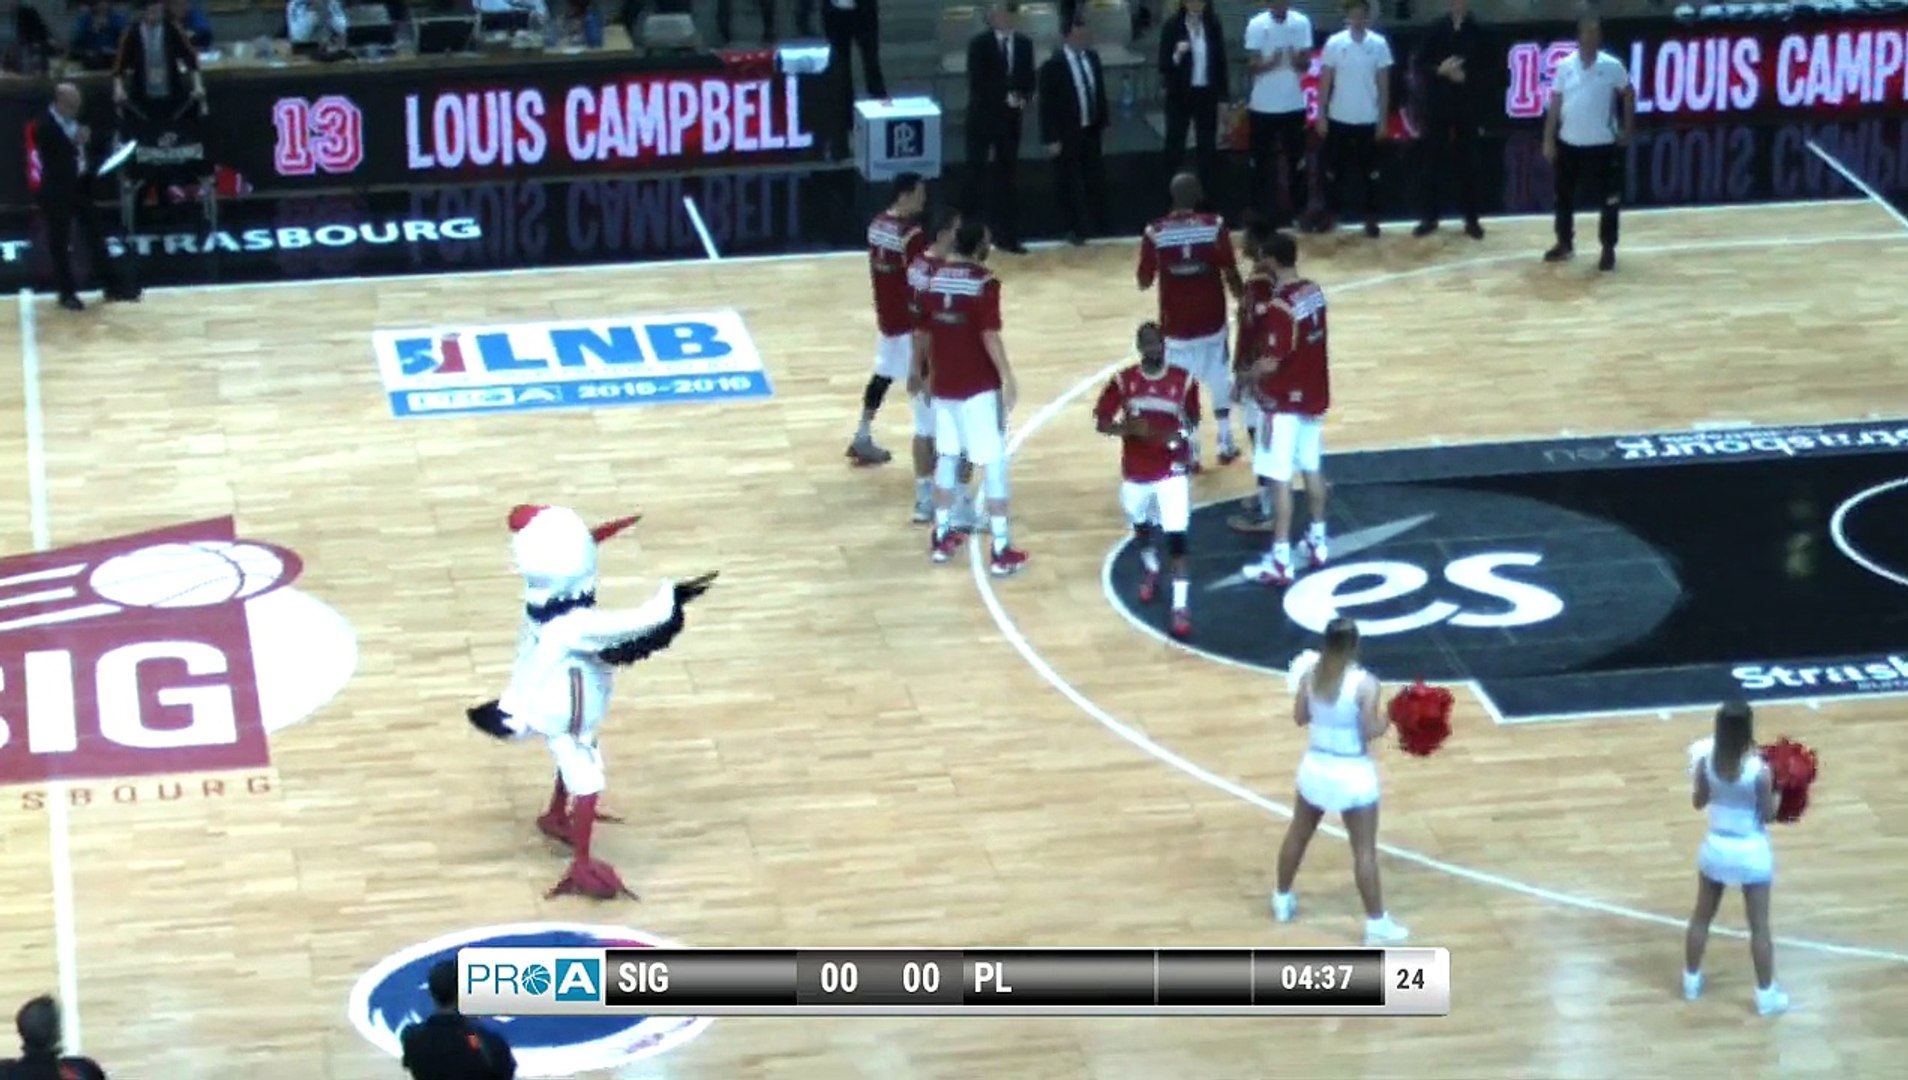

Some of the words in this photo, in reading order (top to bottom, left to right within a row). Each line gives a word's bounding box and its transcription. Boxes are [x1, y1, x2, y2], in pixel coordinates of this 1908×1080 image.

[1630, 35, 1760, 113] LOUIS
[273, 96, 363, 175] 13
[405, 87, 547, 169] LOUIS
[564, 75, 814, 164] CAMPBELL
[475, 322, 732, 372] LNB
[1283, 552, 1564, 637] es
[0, 641, 238, 753] IG
